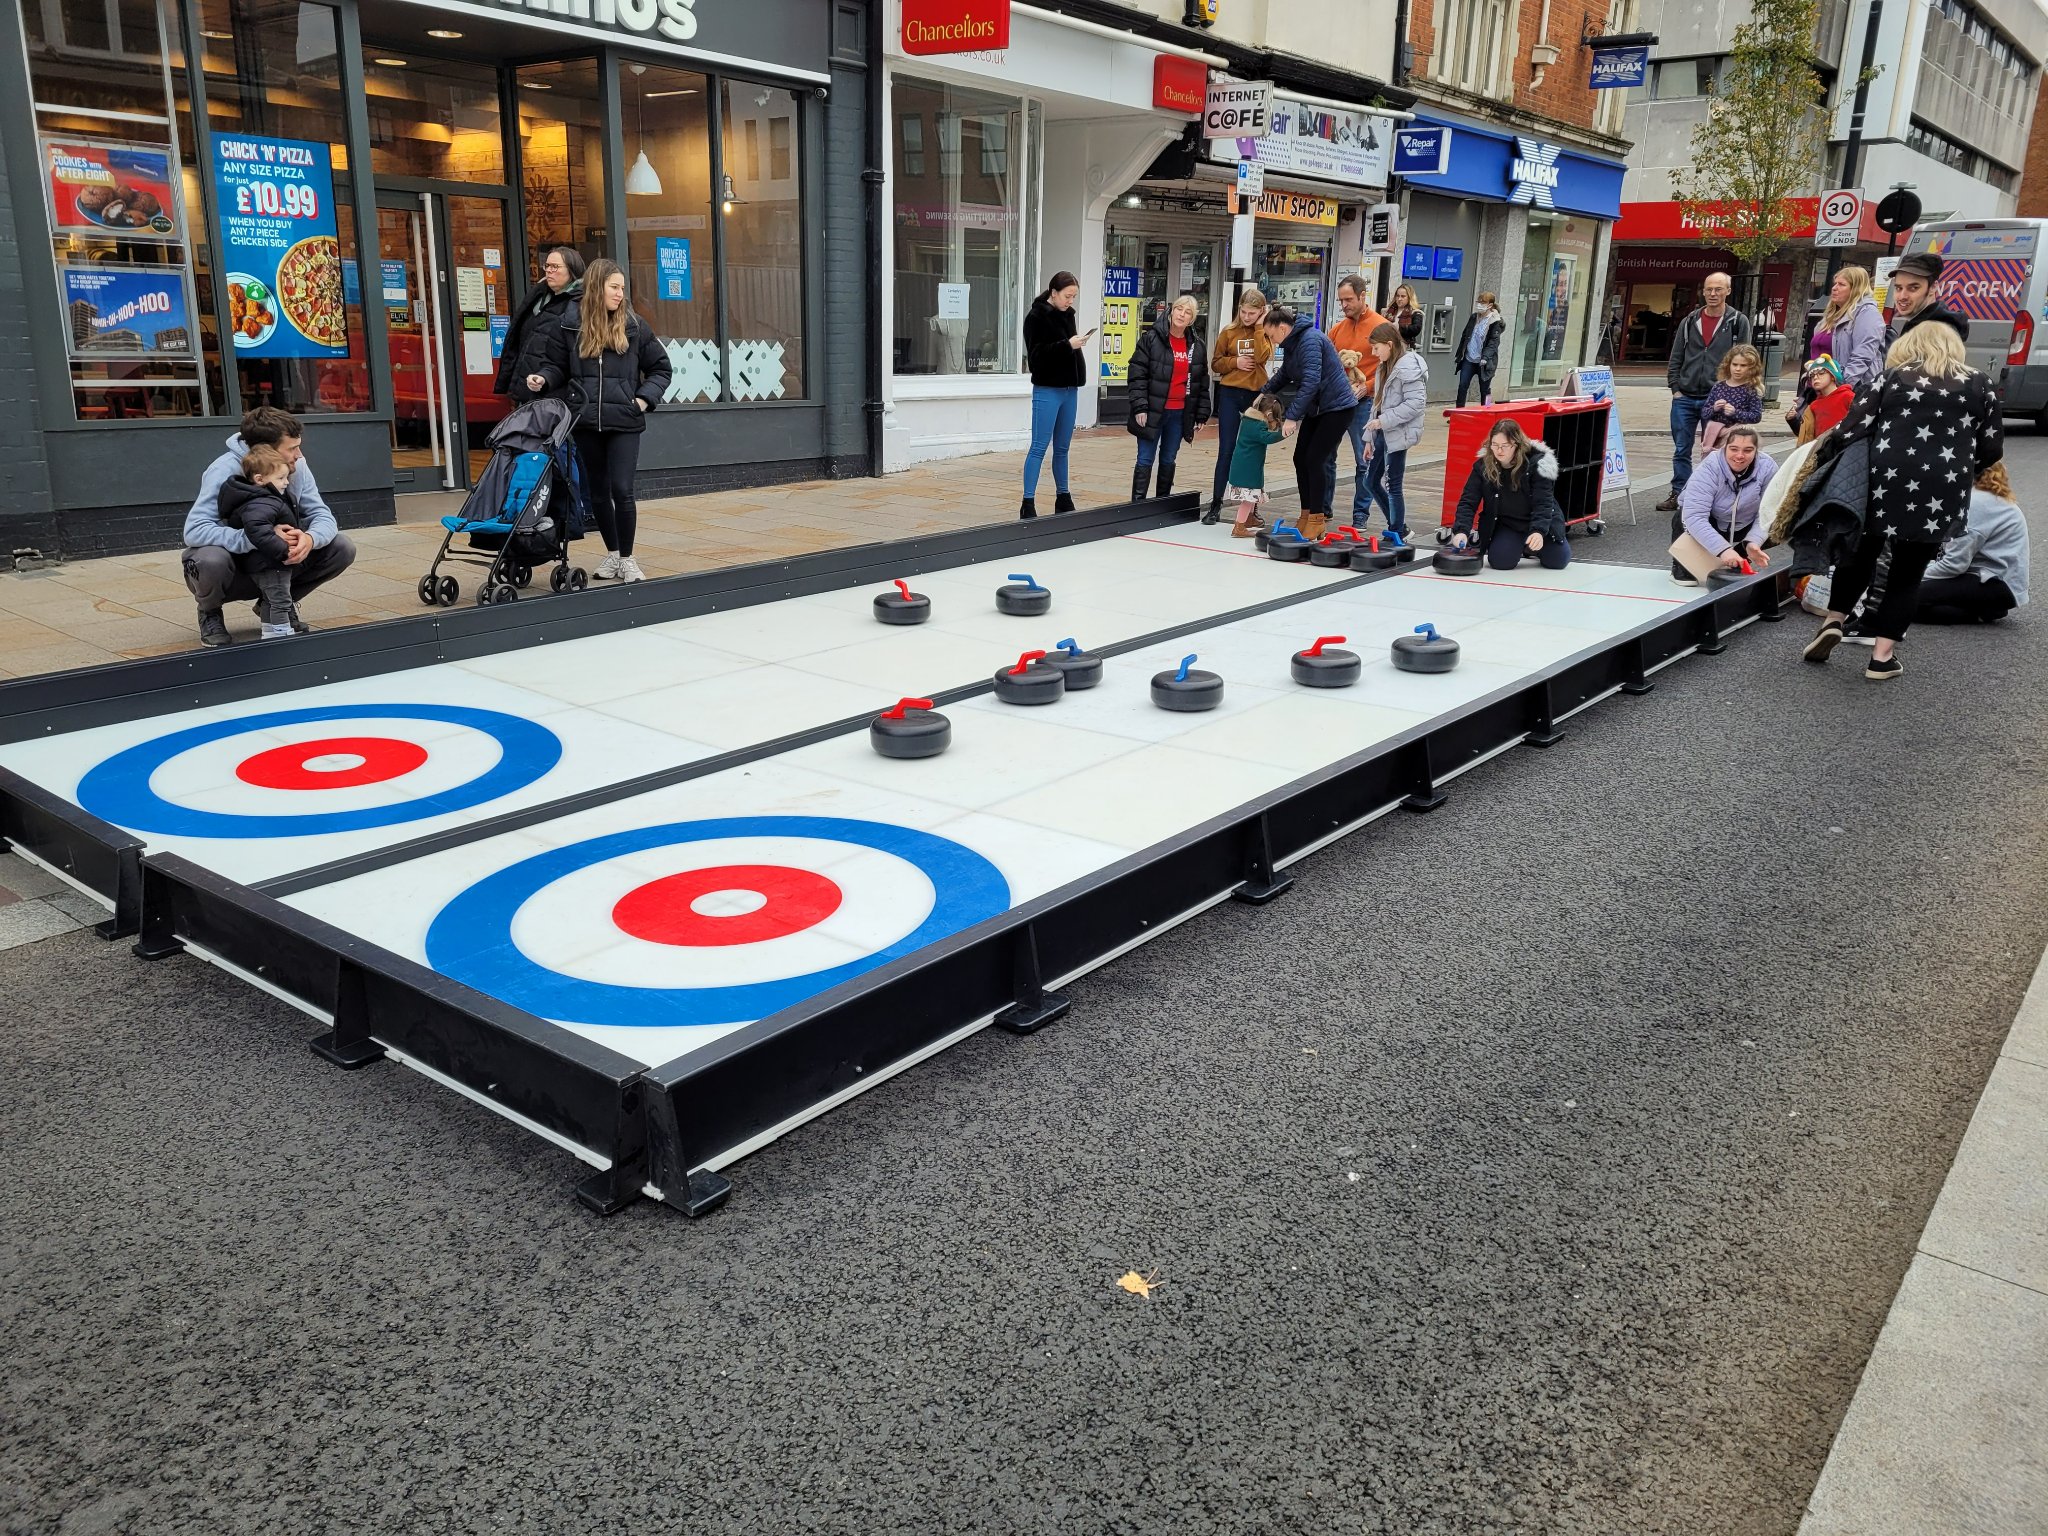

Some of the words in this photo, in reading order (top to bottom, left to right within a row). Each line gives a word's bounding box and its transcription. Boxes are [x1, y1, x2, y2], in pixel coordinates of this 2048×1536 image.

[907, 13, 995, 42] Chancellors
[1593, 62, 1642, 74] HALIFAX
[1209, 89, 1266, 103] INTERNET
[1207, 103, 1265, 129] C@FÉ
[1271, 106, 1291, 135] air
[1412, 138, 1436, 149] Repair
[220, 140, 259, 160] CHICK
[279, 146, 314, 166] PIZZA
[52, 155, 88, 167] COOKIES
[56, 167, 84, 180] AFTER
[86, 170, 110, 182] EIGHT
[224, 162, 246, 174] ANY
[250, 164, 272, 176] SIZE
[274, 166, 306, 180] PIZZA
[1513, 159, 1559, 187] HALIFAX
[236, 176, 250, 185] just
[236, 181, 317, 218] £10.99
[1290, 196, 1325, 219] SHOP
[1326, 206, 1335, 216] UK
[1828, 202, 1854, 216] 30
[229, 216, 255, 227] WHEN
[256, 218, 274, 228] YOU
[276, 220, 292, 229] BUY
[230, 227, 248, 236] ANY
[250, 228, 254, 236] 7
[256, 229, 280, 238] PIECE
[231, 236, 268, 247] CHICKEN
[270, 238, 288, 248] SIDE
[660, 248, 686, 260] DRIVERS
[661, 258, 688, 270] WANTED
[1617, 259, 1646, 268] British
[1648, 259, 1674, 268] Heart
[1676, 259, 1728, 268] Foundation
[1113, 270, 1131, 280] WILL
[1105, 280, 1116, 294] IX
[1118, 280, 1131, 294] IT!
[1963, 281, 2022, 298] CREW
[390, 312, 408, 320] ELITE
